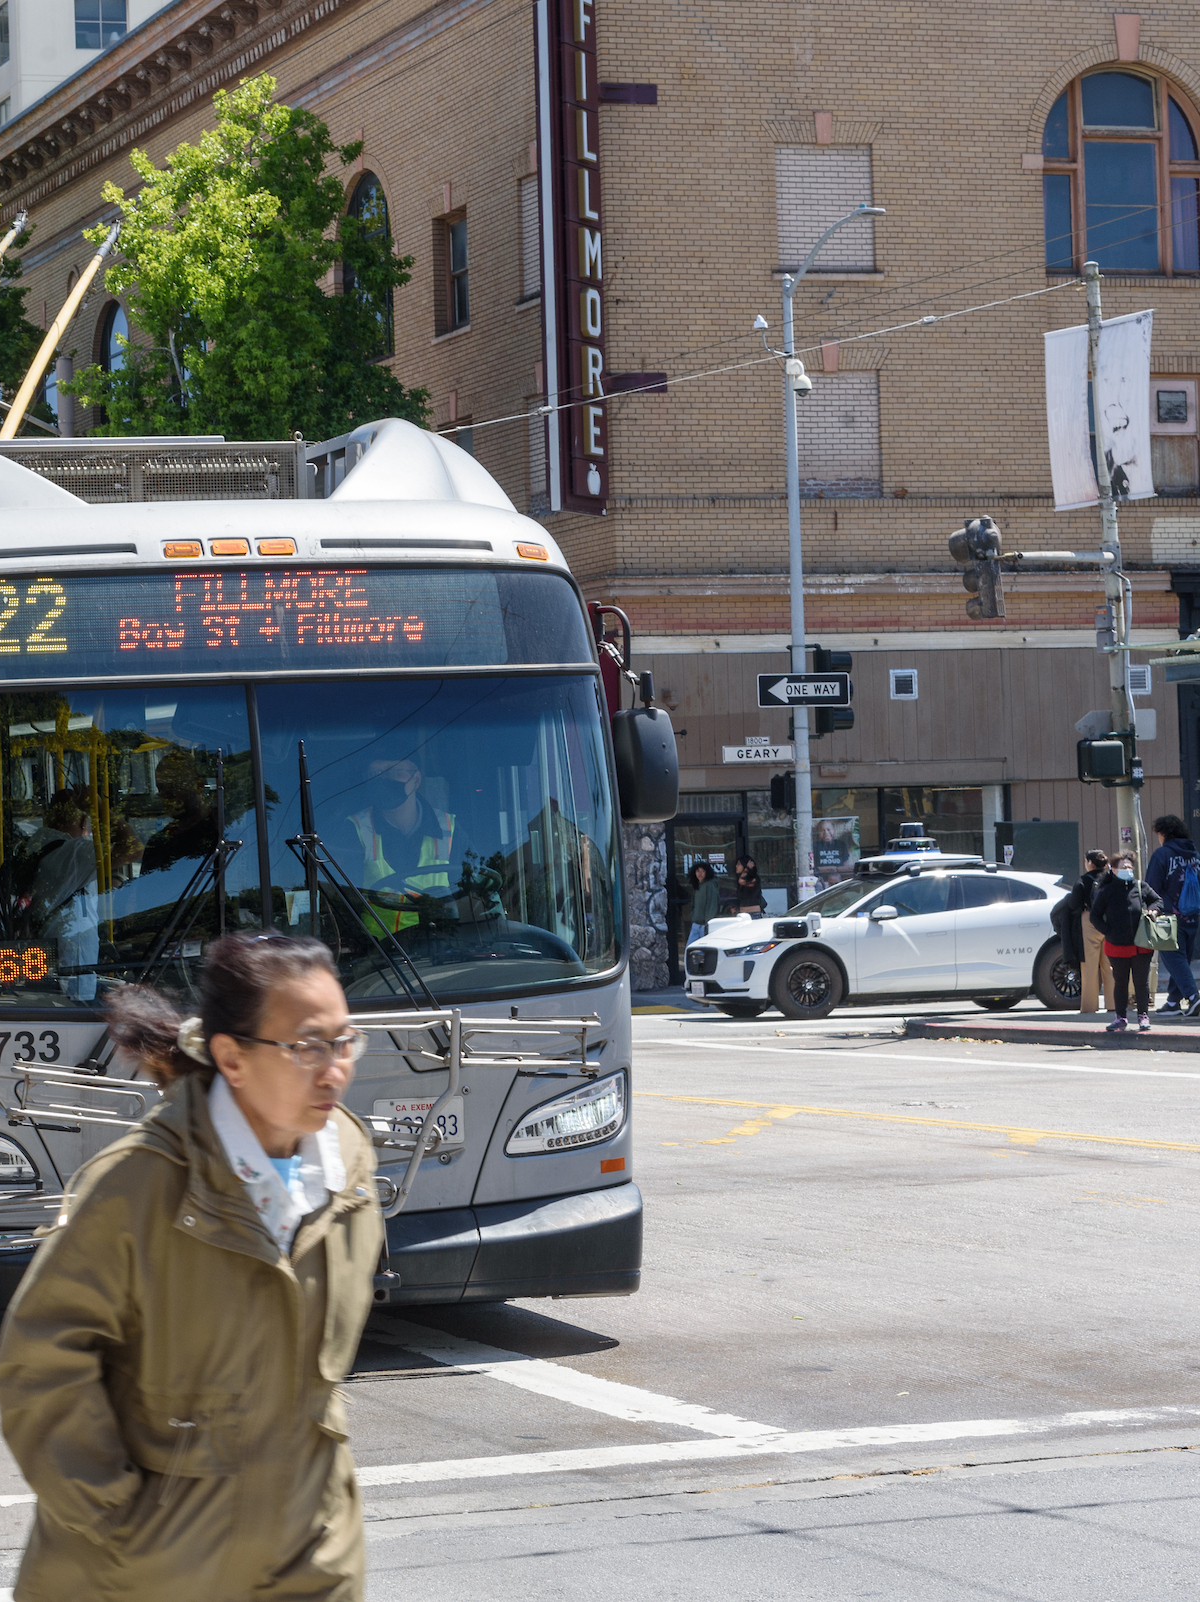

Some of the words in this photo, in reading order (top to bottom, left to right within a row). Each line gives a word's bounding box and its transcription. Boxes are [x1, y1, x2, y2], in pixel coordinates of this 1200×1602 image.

[574, 0, 604, 456] FILLMORE
[174, 570, 368, 612] FILLMORE
[120, 618, 185, 650] Bay
[202, 615, 241, 648] St
[297, 612, 424, 645] Fillmore
[785, 684, 808, 695] ONE
[813, 684, 837, 695] WAY
[747, 737, 763, 745] 1800
[737, 748, 780, 759] GEARY
[996, 946, 1033, 955] WAYMO
[395, 1104, 407, 1112] CA
[410, 1103, 435, 1112] EXEM
